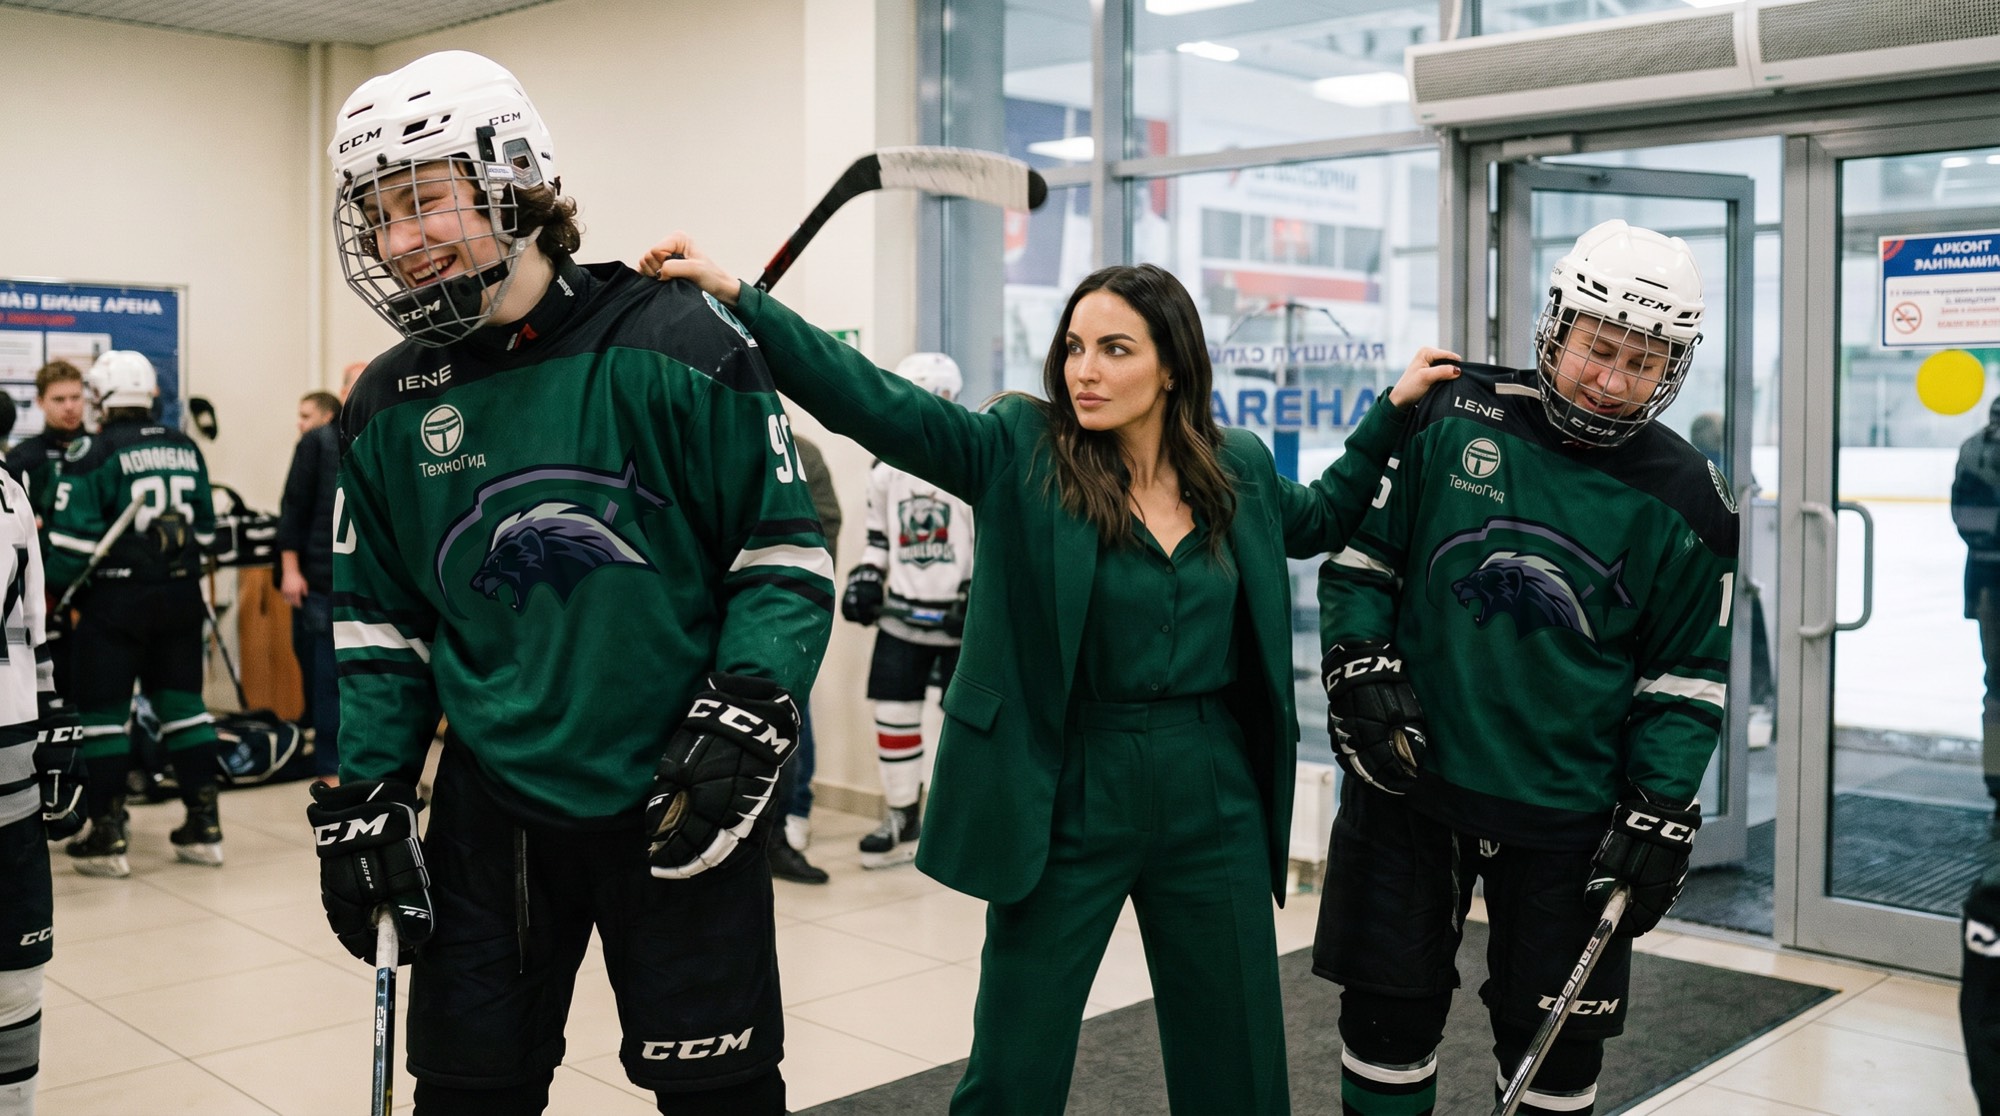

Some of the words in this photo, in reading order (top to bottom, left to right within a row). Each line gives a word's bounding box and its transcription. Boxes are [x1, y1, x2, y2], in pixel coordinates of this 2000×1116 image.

[489, 111, 521, 127] CCM
[338, 127, 382, 154] CCM
[399, 299, 442, 325] CCM
[1622, 291, 1672, 313] CCM
[1454, 396, 1505, 421] LENE
[419, 453, 487, 478] ТехноГид
[1449, 474, 1505, 504] ТехноГид
[1326, 656, 1402, 692] CCM
[687, 699, 791, 755] CCM
[641, 1026, 754, 1060] CCM
